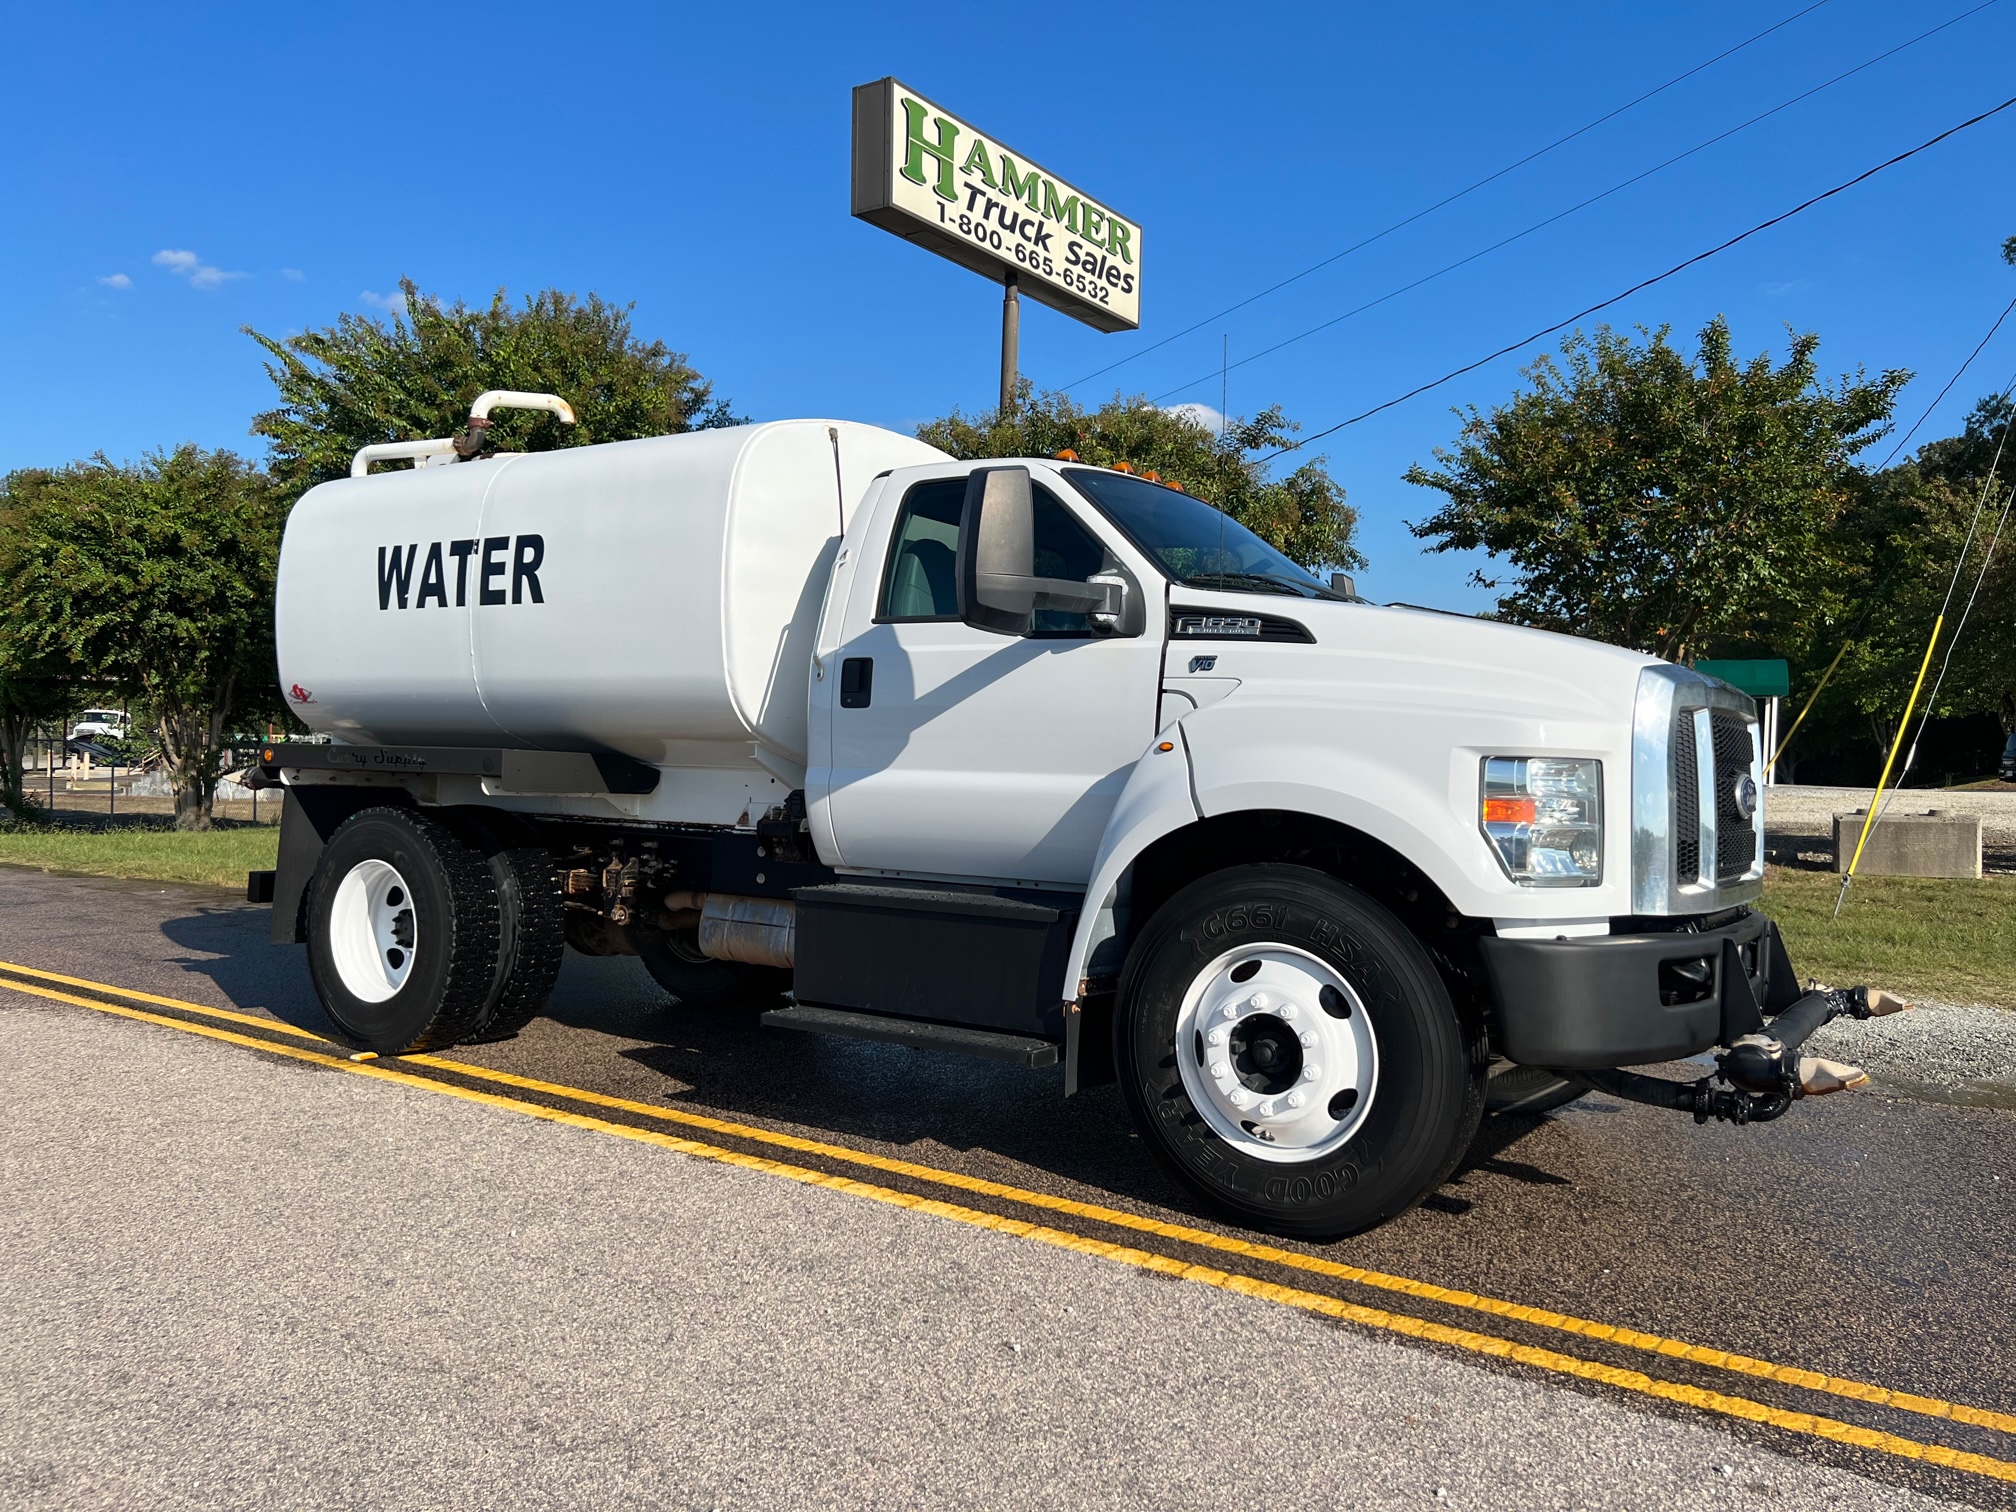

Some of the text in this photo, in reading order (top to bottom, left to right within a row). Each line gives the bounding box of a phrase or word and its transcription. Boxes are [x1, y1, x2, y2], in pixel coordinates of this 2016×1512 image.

[899, 97, 1134, 265] HAMMER
[936, 200, 1110, 305] 1-800-665-6532
[963, 181, 1135, 294] Truck Sales
[377, 533, 545, 611] WATER
[1190, 659, 1215, 673] V10
[1202, 904, 1383, 988] G661 HSA
